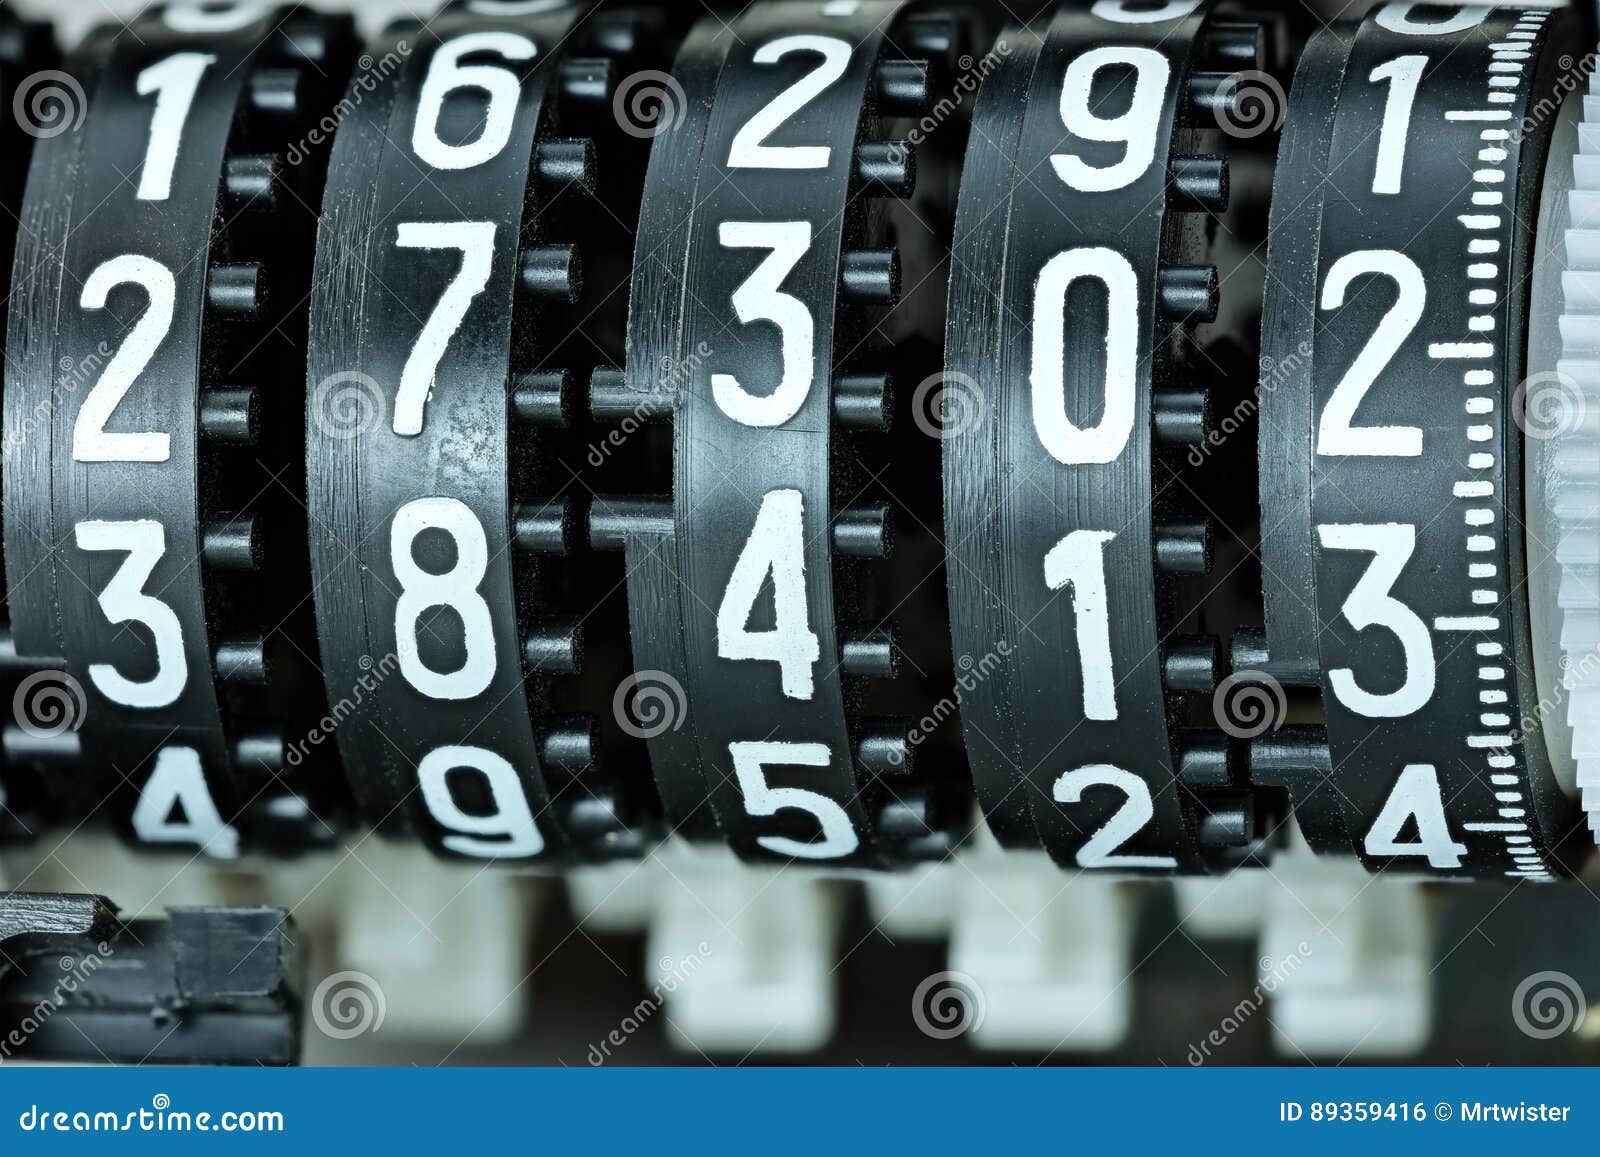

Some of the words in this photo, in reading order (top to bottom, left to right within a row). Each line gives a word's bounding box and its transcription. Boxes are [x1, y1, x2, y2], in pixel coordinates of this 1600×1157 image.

[136, 53, 217, 201] 1
[411, 32, 537, 170] 6
[726, 35, 852, 169] 2
[1049, 46, 1171, 193] 9
[1368, 55, 1429, 195] 1
[73, 254, 176, 463] 2
[392, 221, 498, 436] 7
[711, 221, 815, 427] 3
[1029, 246, 1139, 465] 0
[1317, 249, 1427, 457] 2
[75, 519, 189, 708] 3
[390, 496, 497, 700] 8
[716, 488, 821, 700] 4
[1043, 530, 1119, 721] 1
[1318, 523, 1436, 718] 3
[132, 745, 239, 859] 4
[418, 744, 545, 859] 9
[728, 740, 858, 858] 5
[1053, 764, 1178, 868] 2
[1364, 764, 1467, 868] 4
